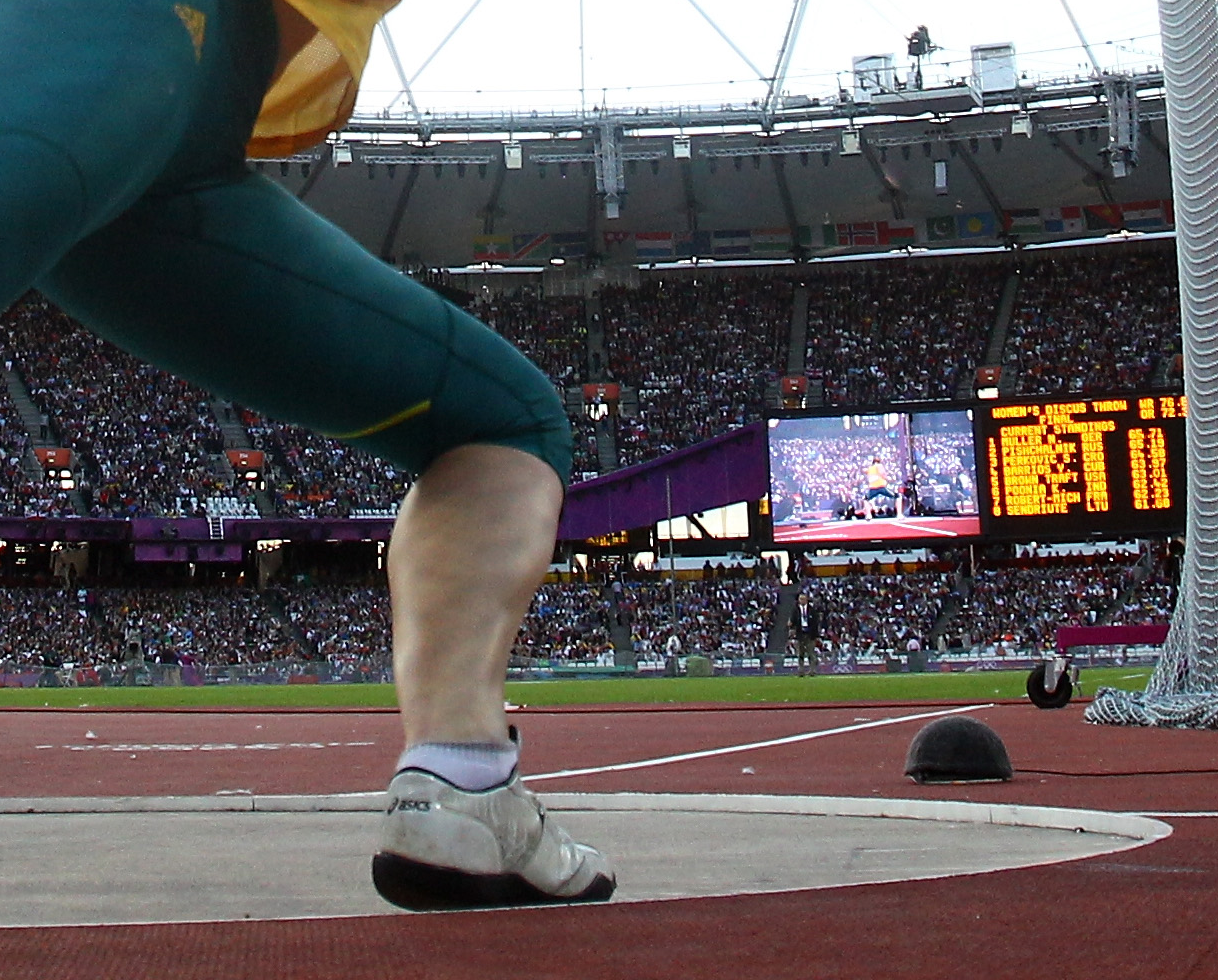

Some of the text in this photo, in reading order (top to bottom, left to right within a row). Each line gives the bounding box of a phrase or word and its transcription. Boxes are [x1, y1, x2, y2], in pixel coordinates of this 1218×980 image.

[992, 400, 1127, 418] WOMEN'S DISCUS THROW
[1139, 398, 1154, 409] WR
[1039, 414, 1074, 425] FINAL
[1140, 409, 1155, 419] OR
[989, 437, 995, 447] 1
[1001, 435, 1042, 446] MULLER
[1081, 432, 1102, 442] GER
[1128, 427, 1163, 439] 65.71
[1000, 421, 1116, 437] CURRENT STANDINGS
[989, 438, 1165, 458] 2 PISHCHALNIK RUS 65.19
[989, 457, 997, 467] 3
[1003, 455, 1057, 467] PERKOVIC
[1063, 453, 1077, 463] S.
[1083, 452, 1104, 462] CRO
[1003, 465, 1051, 476] BARRIOS
[1057, 463, 1071, 473] Y.
[1083, 462, 1105, 471] CUB
[1131, 458, 1166, 469] 63.97
[991, 477, 999, 486] 5
[1004, 475, 1038, 486] BROWN
[1084, 471, 1106, 481] USA
[1132, 468, 1167, 479] 63.01
[991, 487, 1000, 496] 6
[1005, 484, 1046, 496] POONIA
[1051, 484, 1066, 493] K.
[1086, 481, 1107, 491] IND
[993, 488, 1169, 506] 7 ROBERT-MICH FRA 62.23
[1006, 503, 1068, 516] SENDRIUTE
[1087, 501, 1108, 512] LTU
